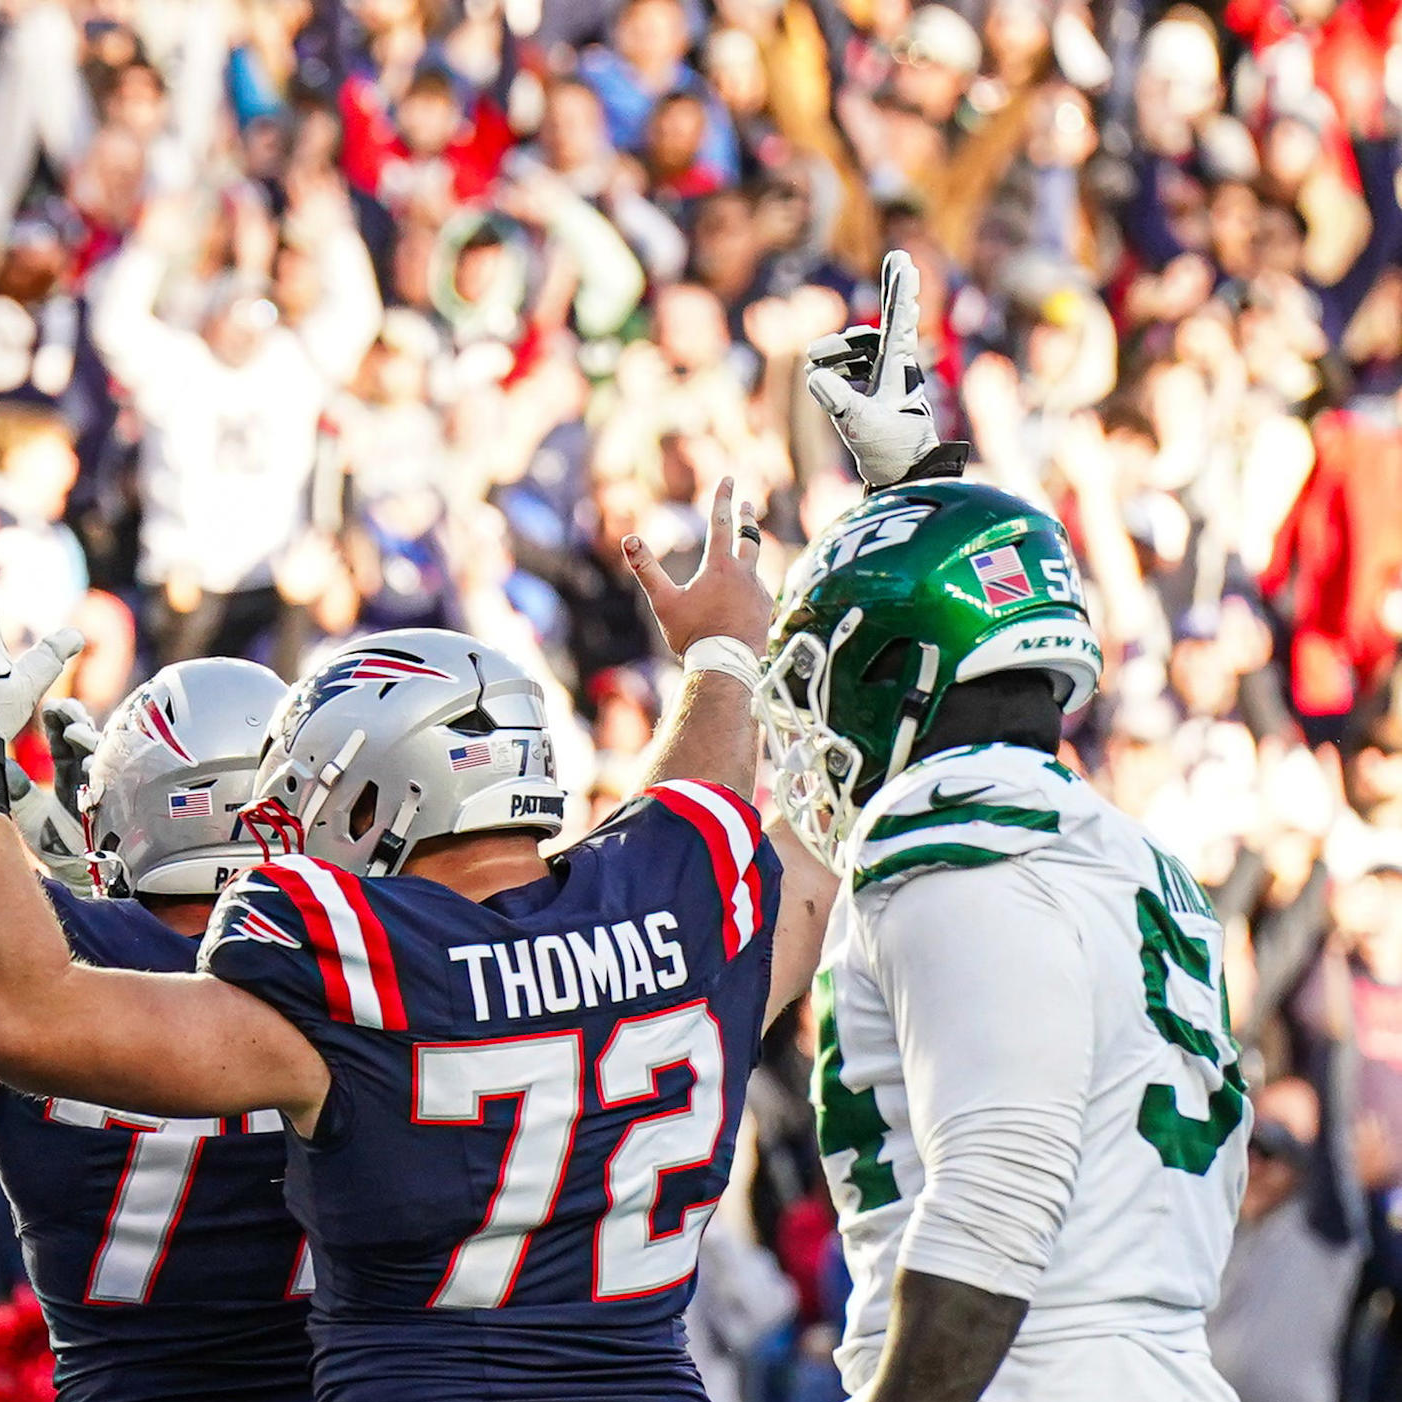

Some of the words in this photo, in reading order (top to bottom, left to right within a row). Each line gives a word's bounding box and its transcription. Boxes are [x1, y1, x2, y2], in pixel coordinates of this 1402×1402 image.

[1015, 635, 1074, 653] NEW
[448, 910, 689, 1022] THOMAS
[1135, 886, 1248, 1177] 5
[410, 997, 727, 1309] 72
